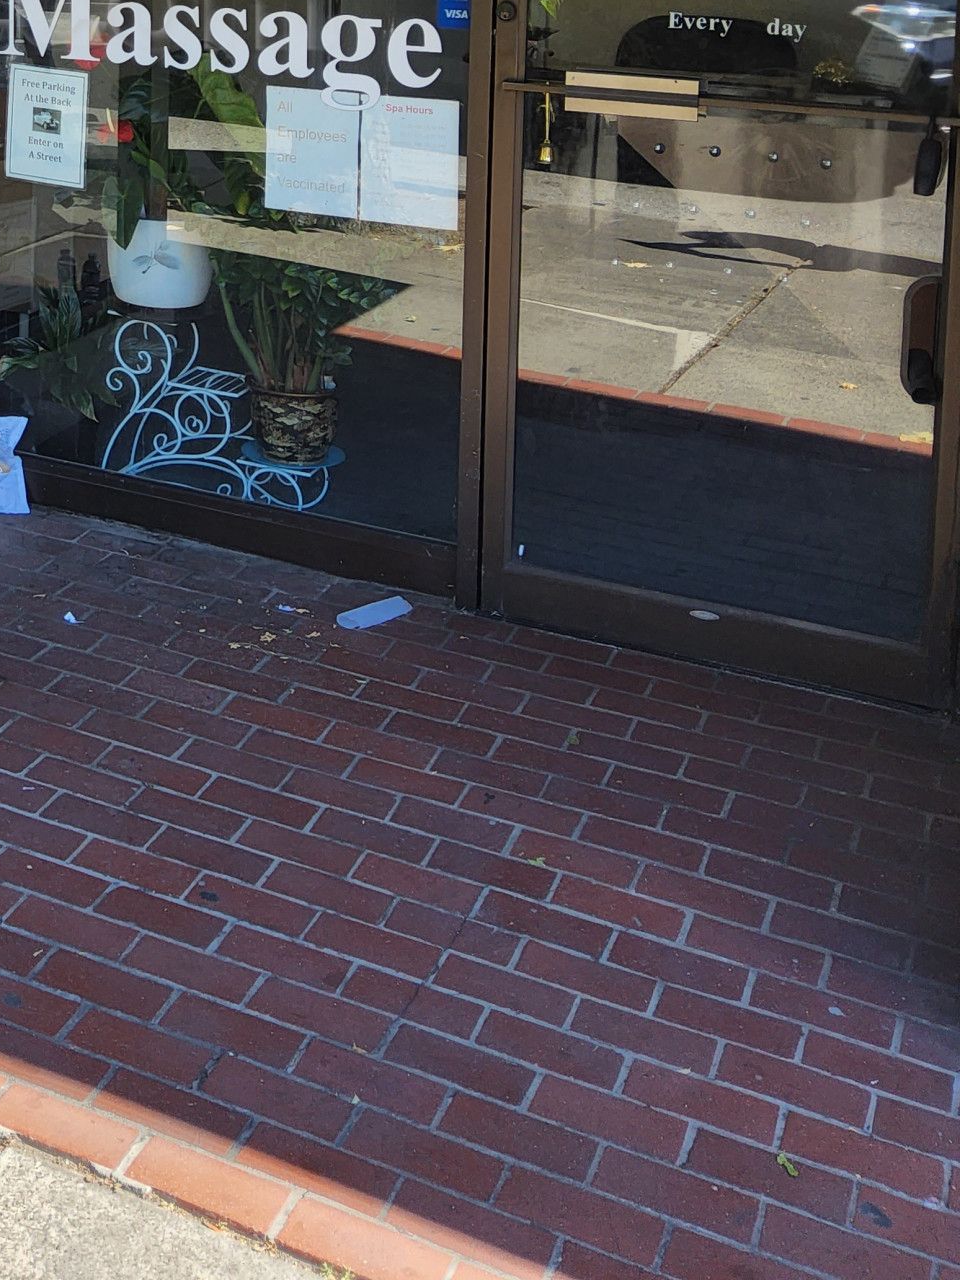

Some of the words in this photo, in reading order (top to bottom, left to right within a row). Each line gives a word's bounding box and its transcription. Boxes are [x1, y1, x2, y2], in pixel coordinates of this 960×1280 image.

[444, 9, 469, 19] VISA
[668, 11, 734, 39] Every
[766, 18, 808, 43] day
[21, 78, 41, 89] Free
[42, 81, 76, 96] Parking
[24, 92, 34, 102] At
[35, 94, 49, 104] the
[51, 96, 72, 108] Back
[277, 100, 293, 113] All
[385, 103, 404, 114] Spa
[406, 106, 434, 115] Hours
[277, 125, 348, 144] Employees
[28, 136, 51, 147] Enter
[53, 141, 64, 149] on
[29, 151, 36, 159] A
[37, 152, 62, 163] Street
[277, 152, 297, 164] are
[277, 176, 346, 194] Vaccinated
